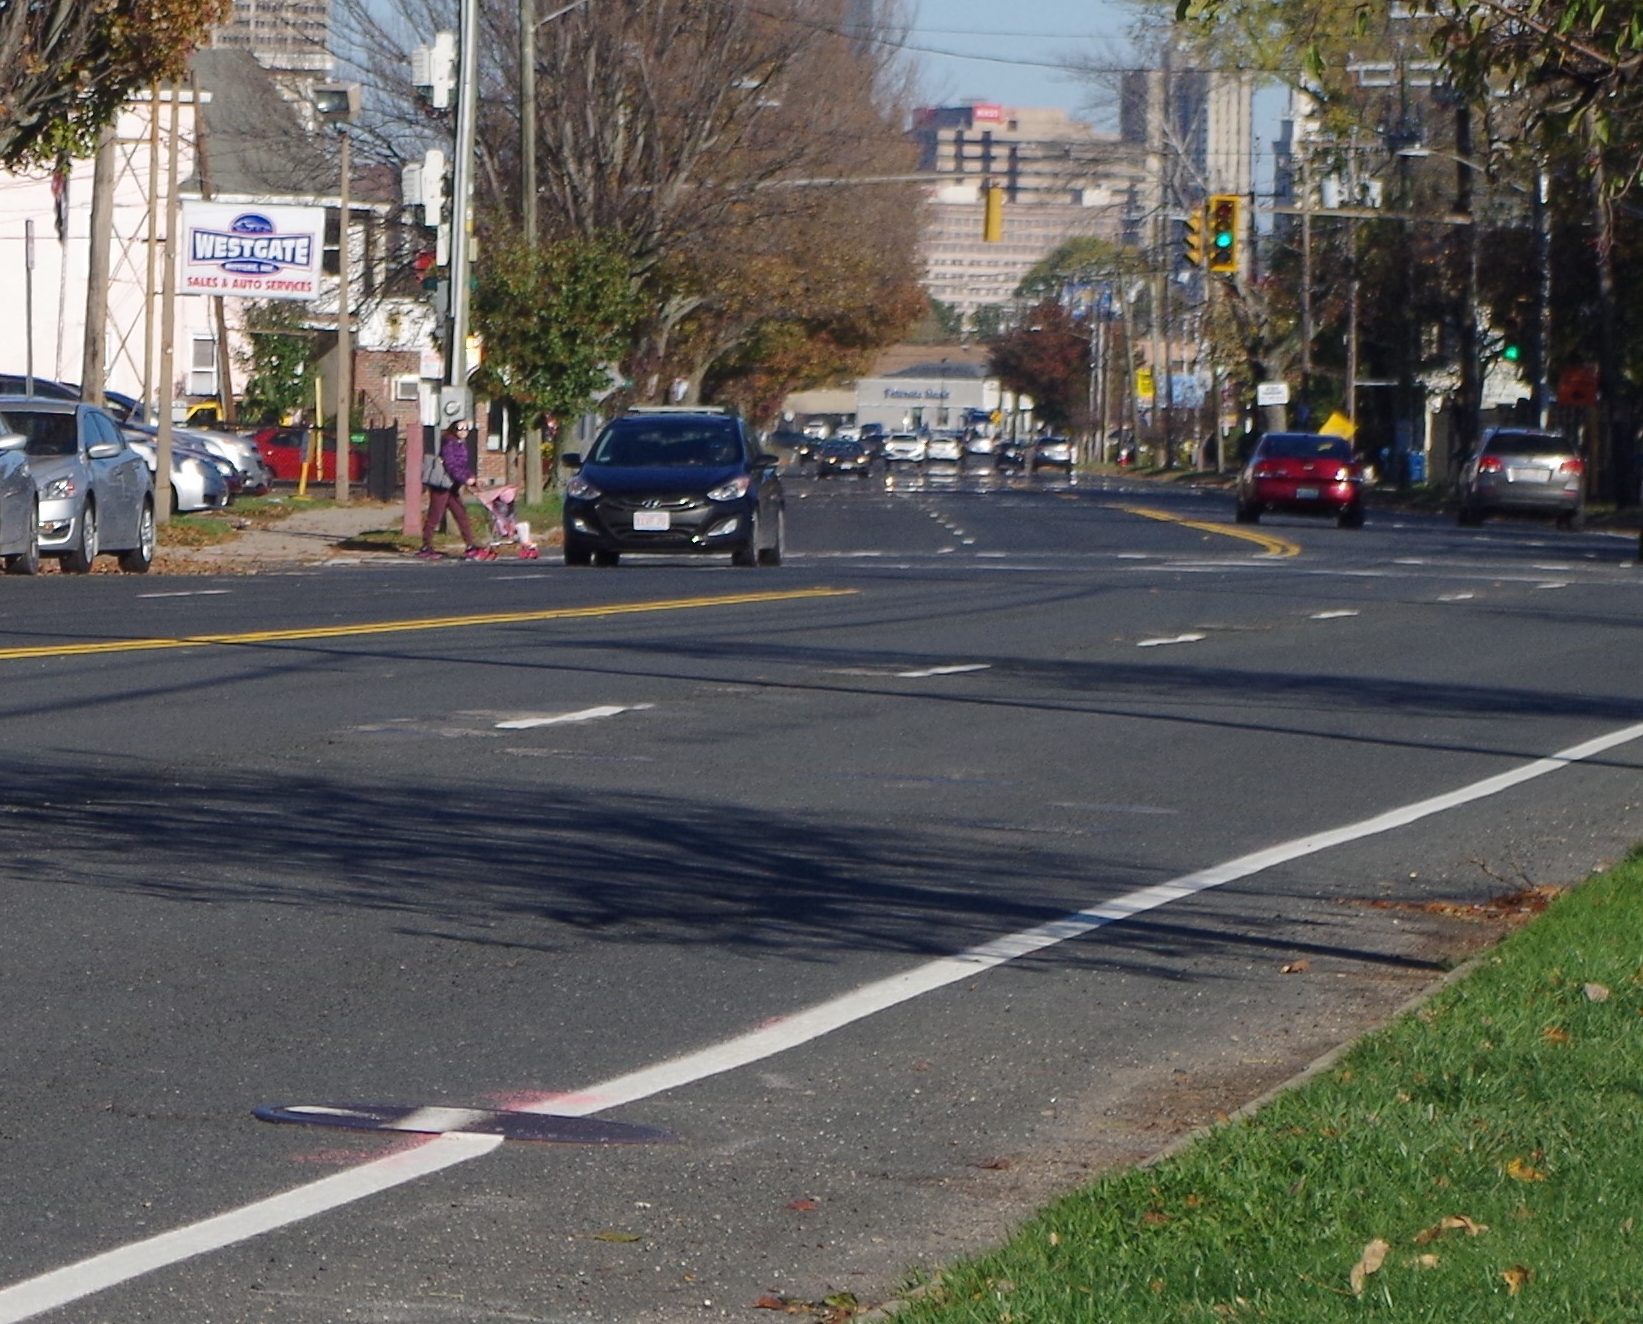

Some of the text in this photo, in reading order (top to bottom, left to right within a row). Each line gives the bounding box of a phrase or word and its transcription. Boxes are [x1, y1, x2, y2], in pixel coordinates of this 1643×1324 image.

[195, 232, 310, 264] WESTGATE
[187, 276, 312, 293] SALES & AUTO SERVICES
